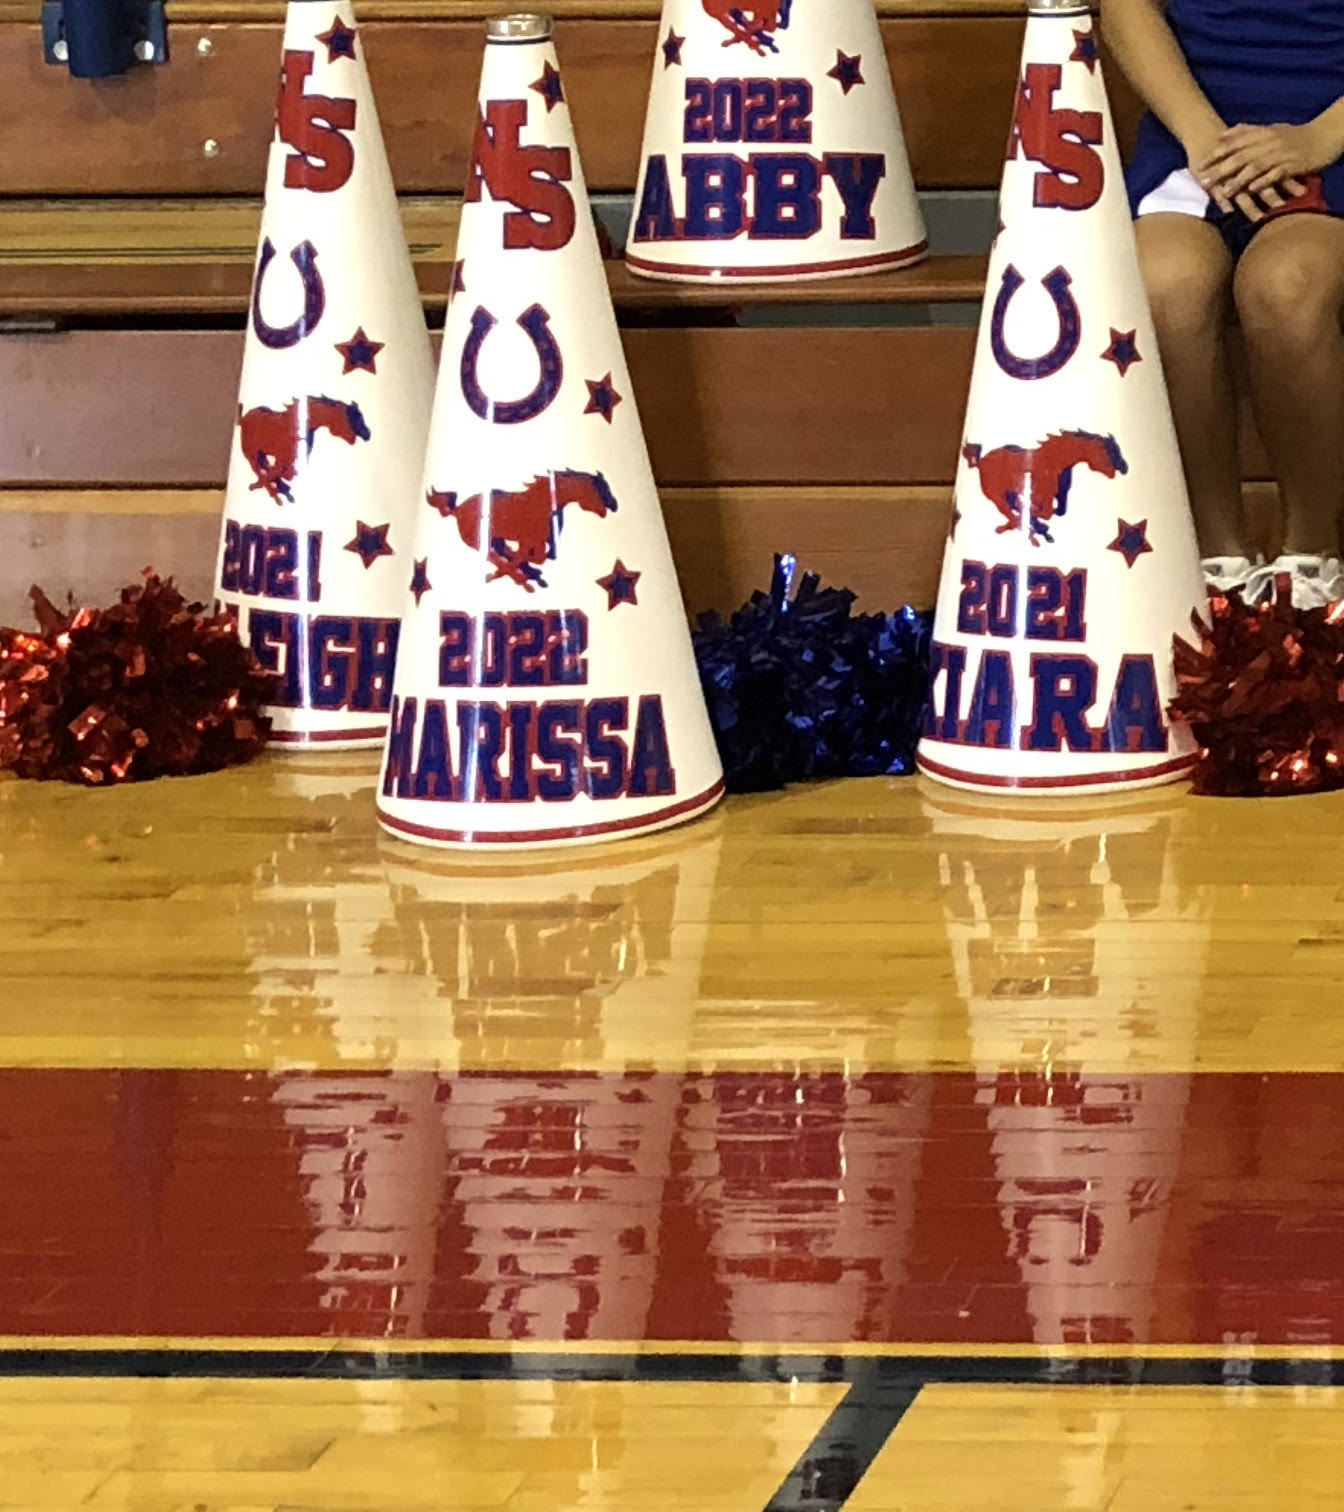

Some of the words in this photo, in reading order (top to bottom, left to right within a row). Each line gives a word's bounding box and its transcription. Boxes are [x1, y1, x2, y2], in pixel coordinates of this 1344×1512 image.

[683, 76, 812, 145] 2022
[463, 98, 577, 252] NS
[632, 151, 886, 242] ABBY
[221, 518, 324, 603] 2021
[956, 558, 1088, 643] 2021
[214, 597, 403, 714] EIGH
[438, 607, 589, 688] 2022
[381, 693, 677, 804] MARISSA
